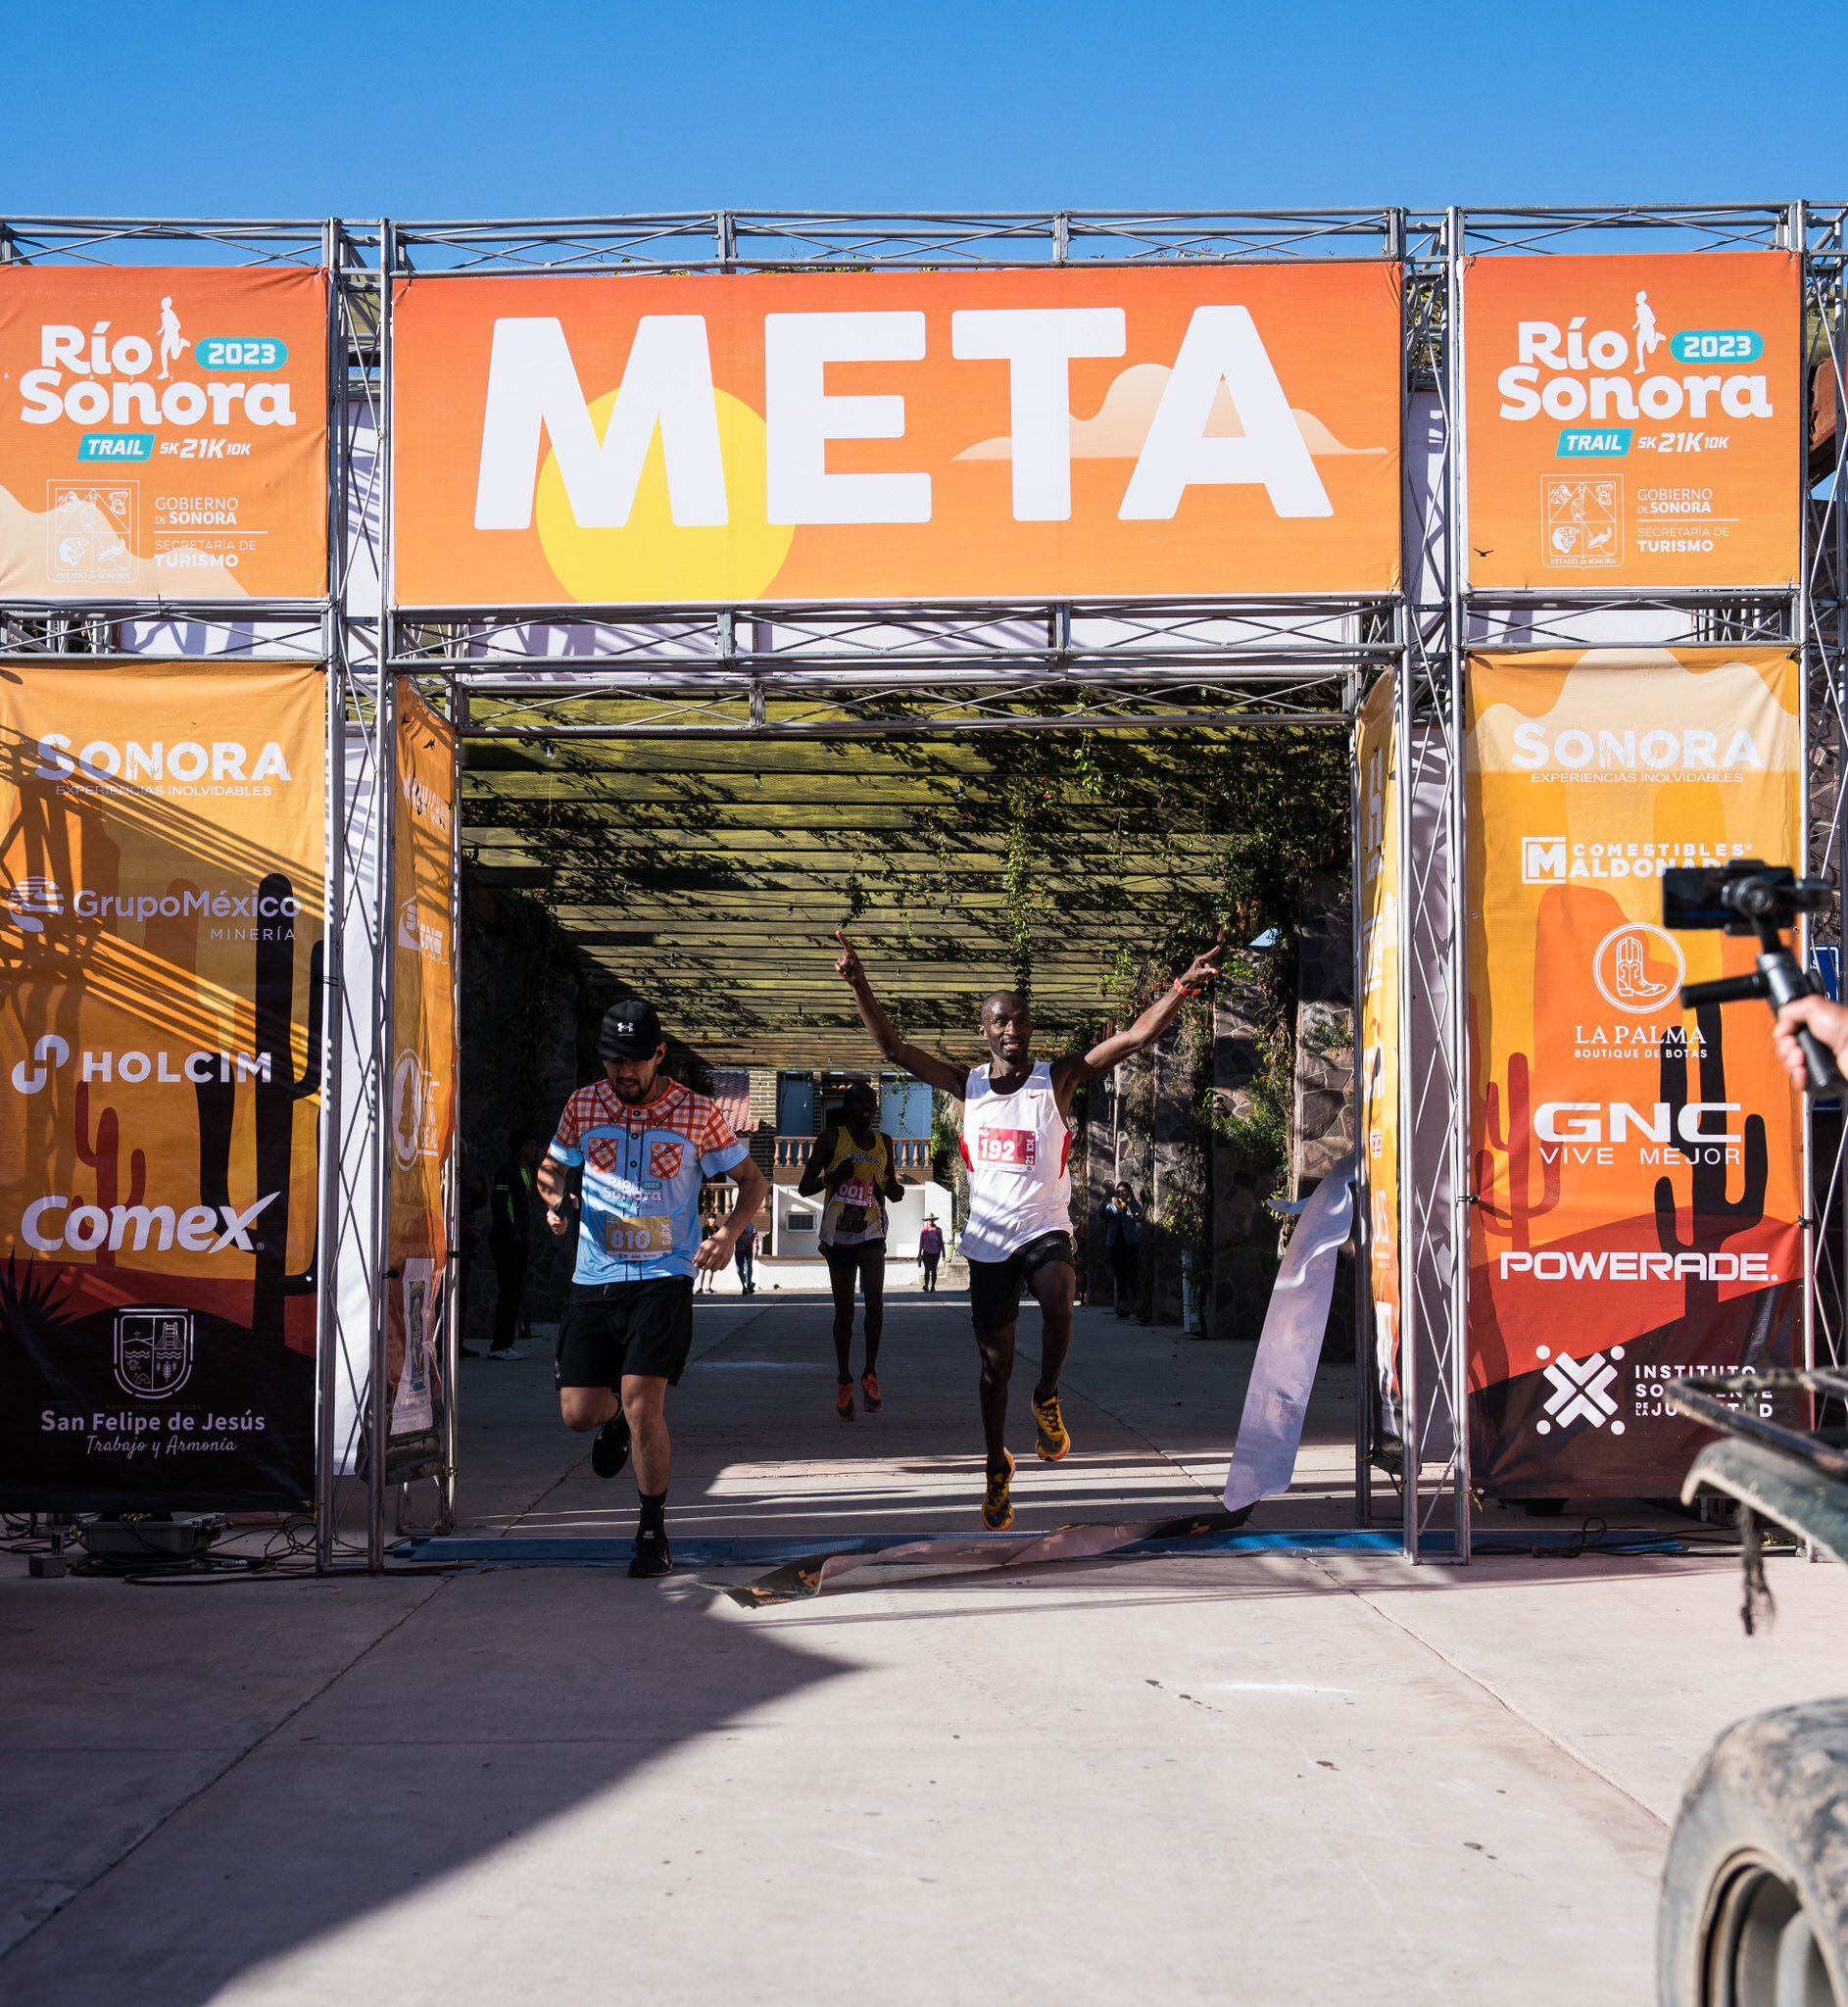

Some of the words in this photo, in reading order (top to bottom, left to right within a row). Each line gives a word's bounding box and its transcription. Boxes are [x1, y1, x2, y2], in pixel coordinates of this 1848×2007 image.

[41, 321, 153, 375] Río
[209, 343, 276, 365] 2023
[1518, 317, 1629, 370] Río
[1683, 335, 1752, 358] 2023
[19, 368, 297, 426] Sonora
[1497, 366, 1774, 421] Sonora
[474, 305, 1335, 531] META
[87, 439, 144, 456] TRAIL
[159, 442, 179, 455] 5K
[179, 438, 227, 459] 21K
[226, 443, 252, 456] 10K
[1567, 434, 1623, 451] TRAIL
[1637, 436, 1657, 450] 5K
[1657, 432, 1705, 453] 21K
[1704, 437, 1728, 450] 10K
[155, 497, 239, 511] GOBIERNO
[1637, 488, 1713, 502] GOBIERNO
[155, 516, 168, 525] DE
[169, 511, 237, 525] SONORA
[1650, 501, 1712, 514] SONORA
[1637, 525, 1711, 538] SECRETARÍA
[1714, 527, 1729, 537] DE
[155, 538, 235, 551] SECRETARÍA
[239, 540, 257, 551] DE
[1637, 540, 1714, 553] TURISMO
[154, 554, 239, 568] TURISMO
[1510, 722, 1763, 769] SONORA
[34, 733, 293, 782] SONORA
[1532, 772, 1637, 783] EXPERIENCIAS
[1641, 772, 1744, 783] INOLVIDABLES
[56, 785, 164, 796] EXPERIENCIAS
[168, 785, 273, 796] INOLVIDABLES
[73, 890, 302, 922] GrupoMéxico
[211, 926, 296, 941] MINERÍA
[1575, 1025, 1609, 1045] LA
[1614, 1025, 1707, 1045] PALMA
[1575, 1049, 1639, 1058] BOUTIQUE
[1645, 1049, 1660, 1058] DE
[1666, 1049, 1708, 1058] BOTAS
[82, 1051, 272, 1083] HOLCIM
[1533, 1101, 1741, 1144] GNC
[981, 1139, 1015, 1161] 192
[1539, 1148, 1614, 1165] VIVE
[1640, 1148, 1741, 1166] MEJOR
[21, 1191, 281, 1253] Comex
[610, 1229, 651, 1249] 810
[1500, 1251, 1771, 1281] POWERADE
[40, 1410, 84, 1431] San
[92, 1412, 163, 1435] Felipe
[168, 1412, 194, 1431] de
[201, 1409, 266, 1432] Jesús
[86, 1435, 148, 1460] Trabajo
[152, 1444, 160, 1459] y
[165, 1435, 237, 1454] Armonía
